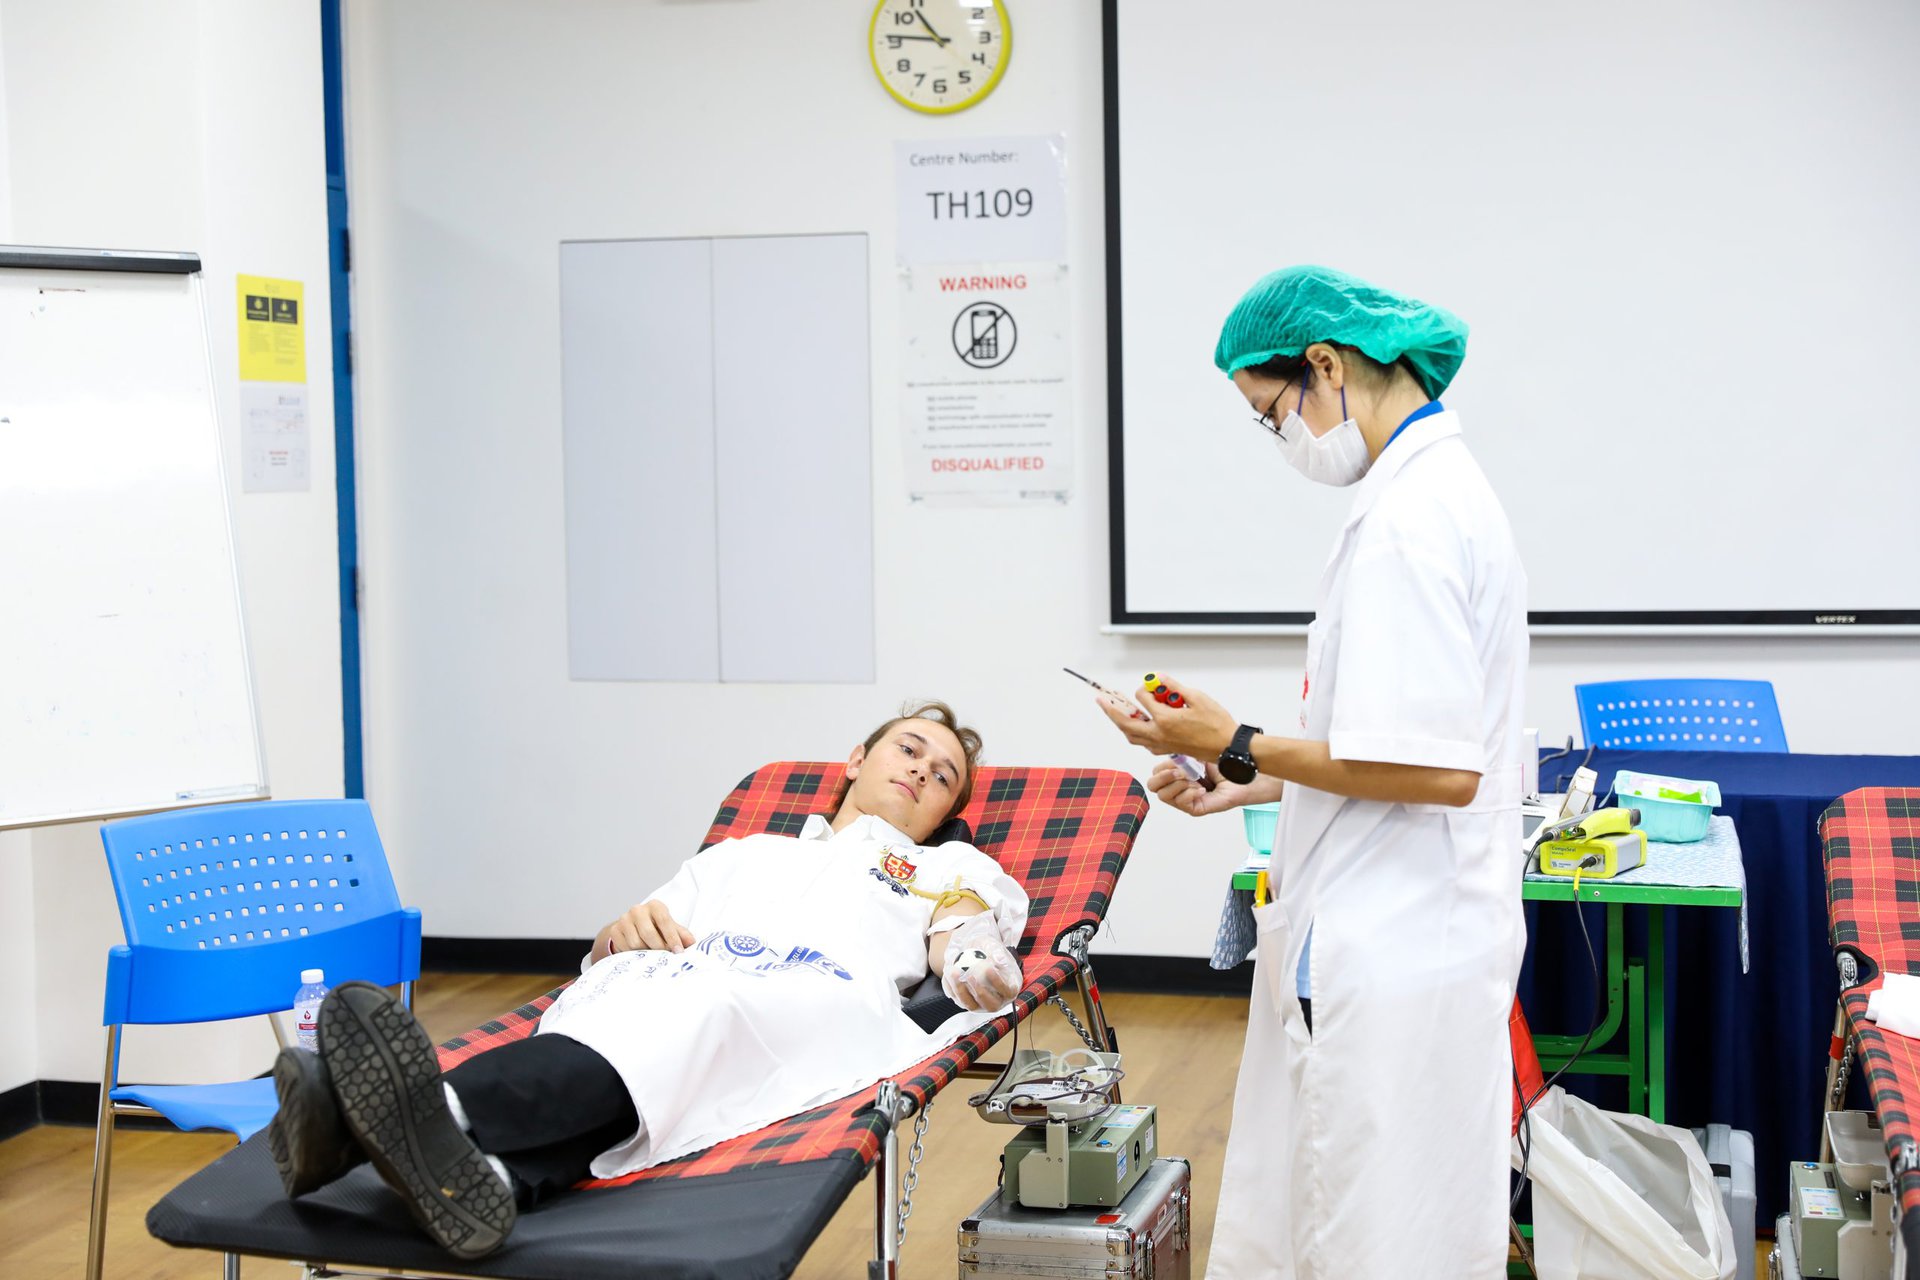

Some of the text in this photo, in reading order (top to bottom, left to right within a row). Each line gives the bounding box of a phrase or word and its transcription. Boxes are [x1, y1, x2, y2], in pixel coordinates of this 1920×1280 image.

[895, 12, 914, 25] 10
[971, 8, 984, 19] 2
[887, 35, 902, 49] 9
[979, 31, 991, 44] 3
[897, 59, 911, 73] 8
[972, 53, 985, 65] 4
[914, 73, 926, 87] 7
[958, 71, 971, 84] 5
[933, 79, 947, 94] 6
[909, 150, 1019, 167] Centre Number:
[926, 188, 1033, 220] TH109
[939, 275, 1027, 292] WARNING
[931, 456, 1045, 473] DISQUALIFIED
